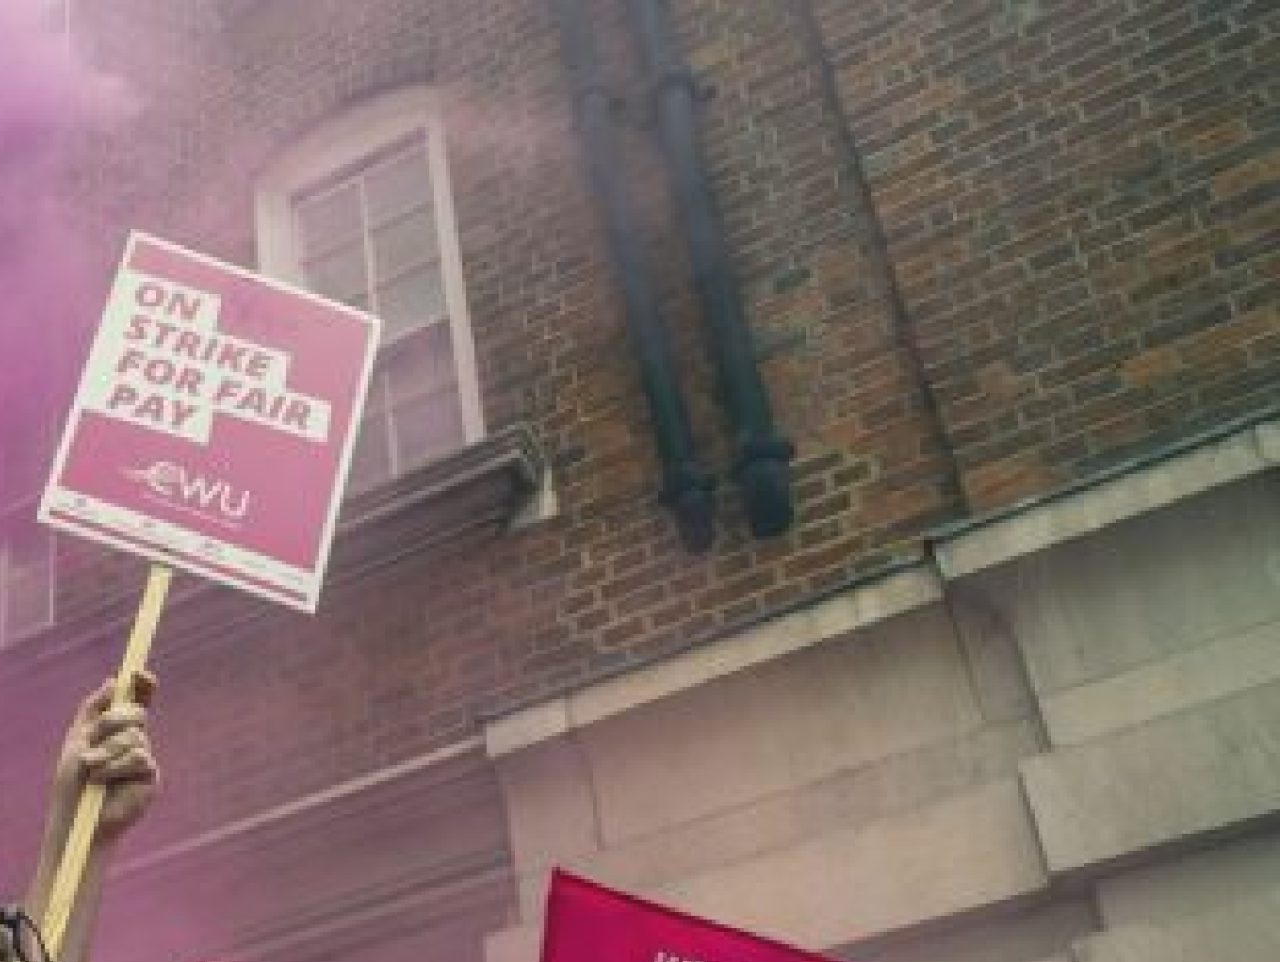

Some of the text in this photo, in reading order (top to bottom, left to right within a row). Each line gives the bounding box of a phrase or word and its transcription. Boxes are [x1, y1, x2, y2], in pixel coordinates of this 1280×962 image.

[135, 282, 200, 320] ON
[123, 314, 271, 378] STRIKE
[107, 384, 194, 426] PAY
[117, 350, 311, 427] FOR FAIR
[124, 460, 250, 517] CWU
